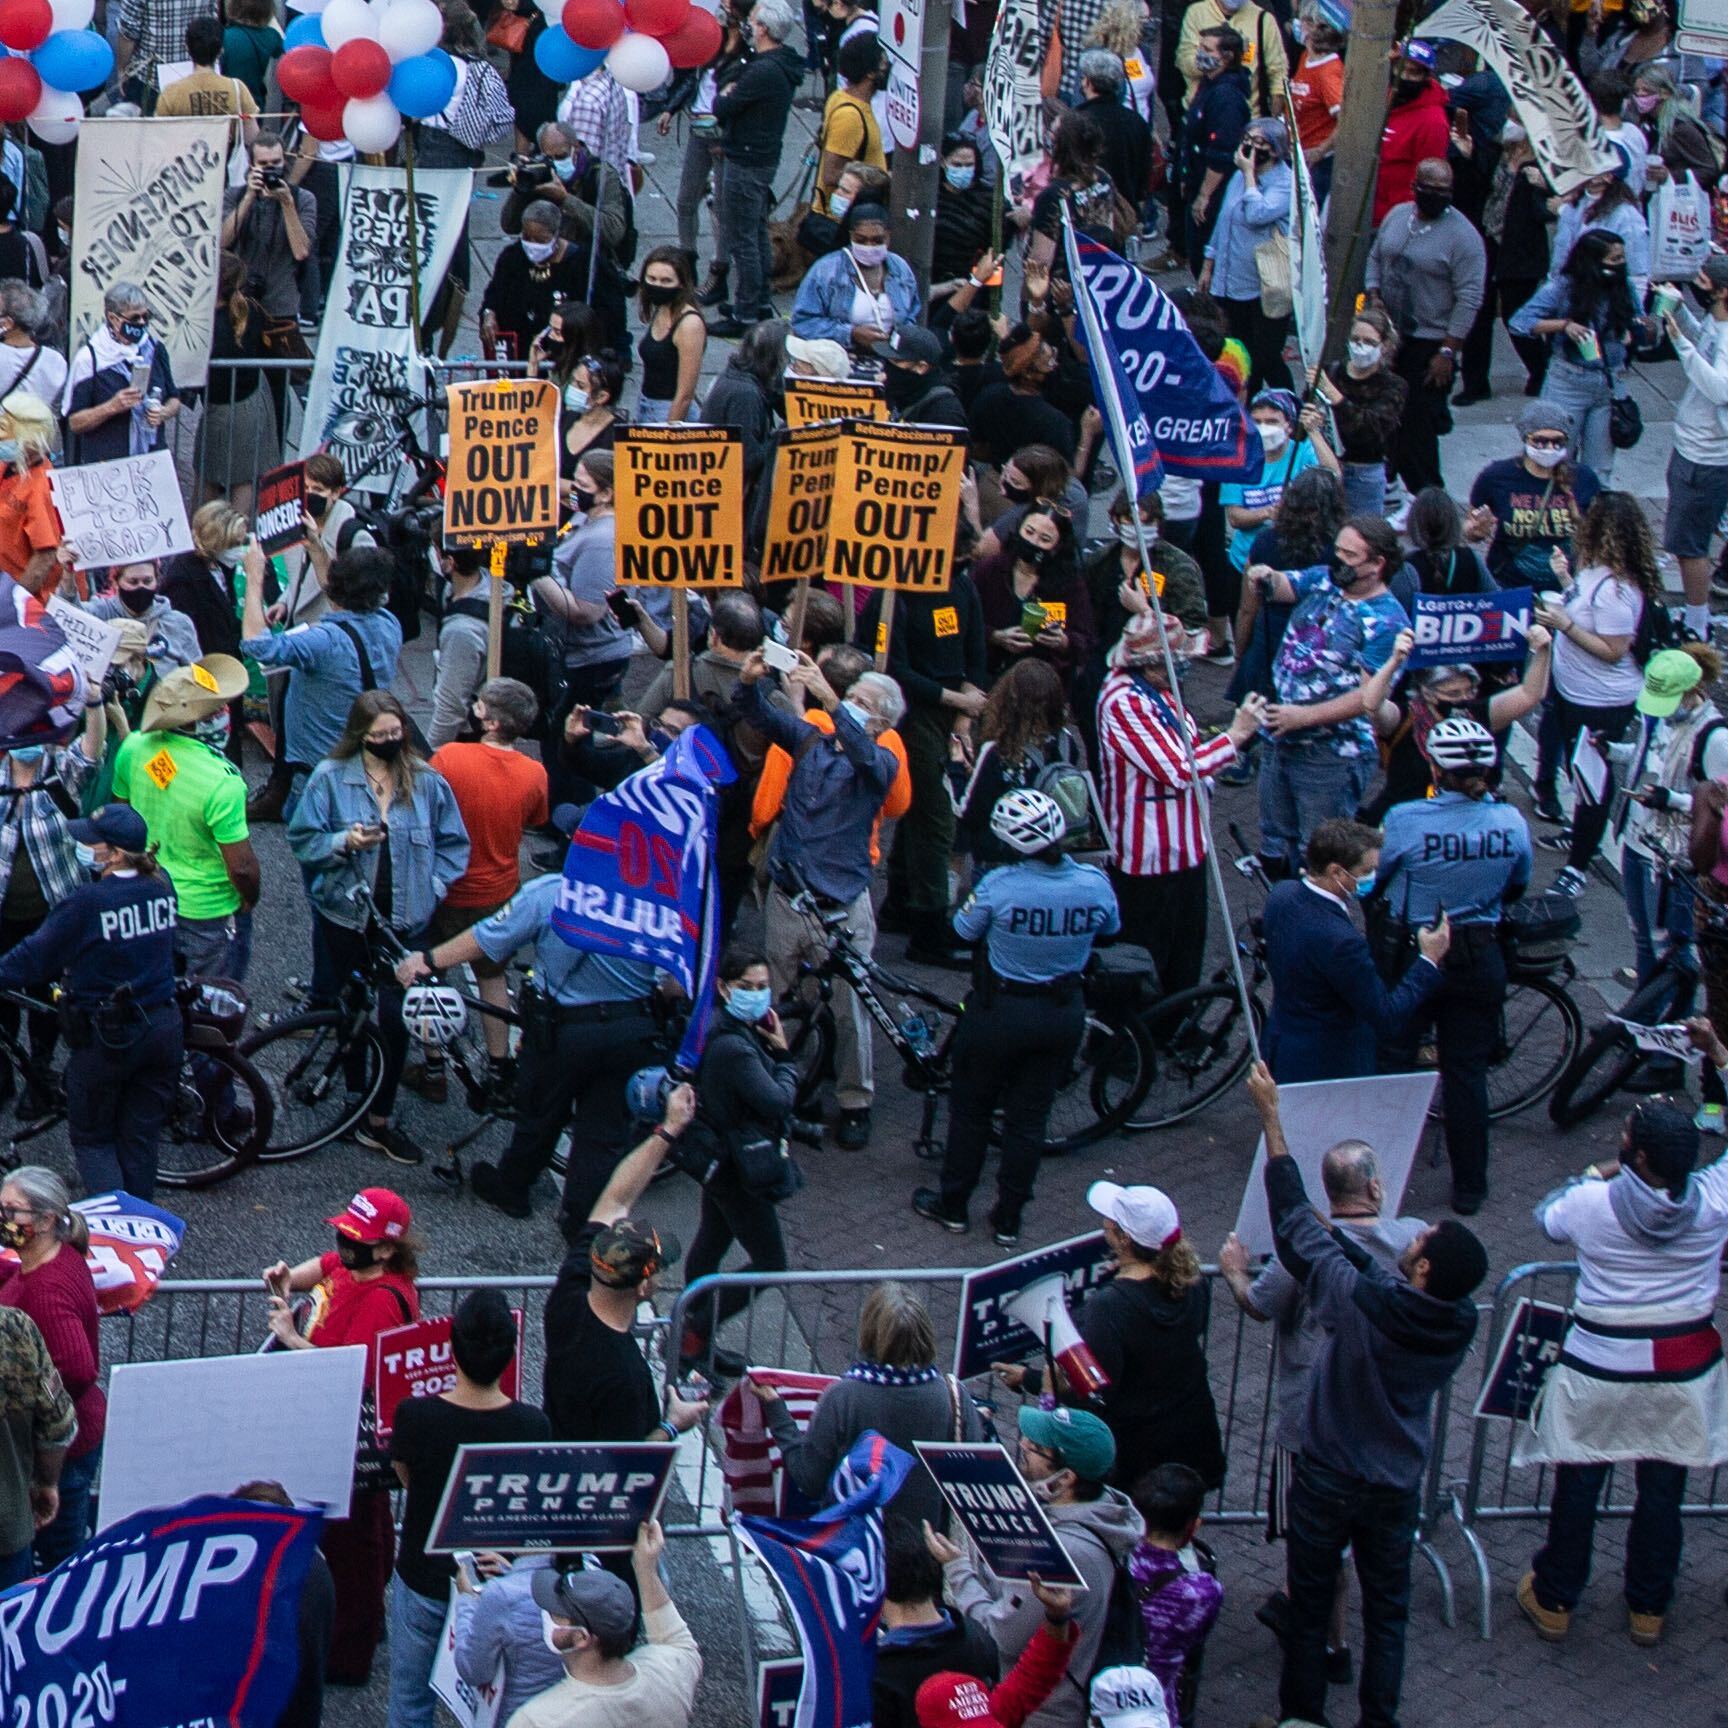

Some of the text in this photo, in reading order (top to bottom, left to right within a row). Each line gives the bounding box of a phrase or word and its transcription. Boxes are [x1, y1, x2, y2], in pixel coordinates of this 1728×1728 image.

[457, 384, 548, 413] Trump/
[464, 415, 538, 440] Pence
[628, 428, 728, 440] RefuseFascism.org
[854, 421, 953, 442] RefuseFascism.org
[1155, 416, 1231, 445] GREAT!
[467, 441, 536, 483] OUT
[626, 445, 730, 473] Trump/
[851, 441, 953, 476] Trump/
[62, 458, 157, 515] FUCK
[634, 473, 722, 499] Pence
[855, 469, 942, 499] Pence
[450, 484, 549, 529] NOW!
[854, 499, 936, 542] OUT
[637, 502, 720, 541] OUT
[78, 517, 176, 561] BRADY
[620, 544, 734, 582] NOW!
[831, 538, 944, 584] NOW!
[1416, 598, 1473, 613] LGBTQ+
[1414, 607, 1529, 645] BIDEN
[1423, 829, 1516, 863] POLICE
[101, 897, 178, 941] POLICE
[1010, 907, 1100, 937] POLICE
[466, 1472, 658, 1496] TRUMP
[943, 1481, 1028, 1510] TRUMP
[474, 1494, 631, 1512] PENCE
[461, 1513, 632, 1523] MAKE AMERICA GREAT AGAIN!
[968, 1510, 1040, 1535] PENCE
[1114, 1688, 1156, 1711] USA
